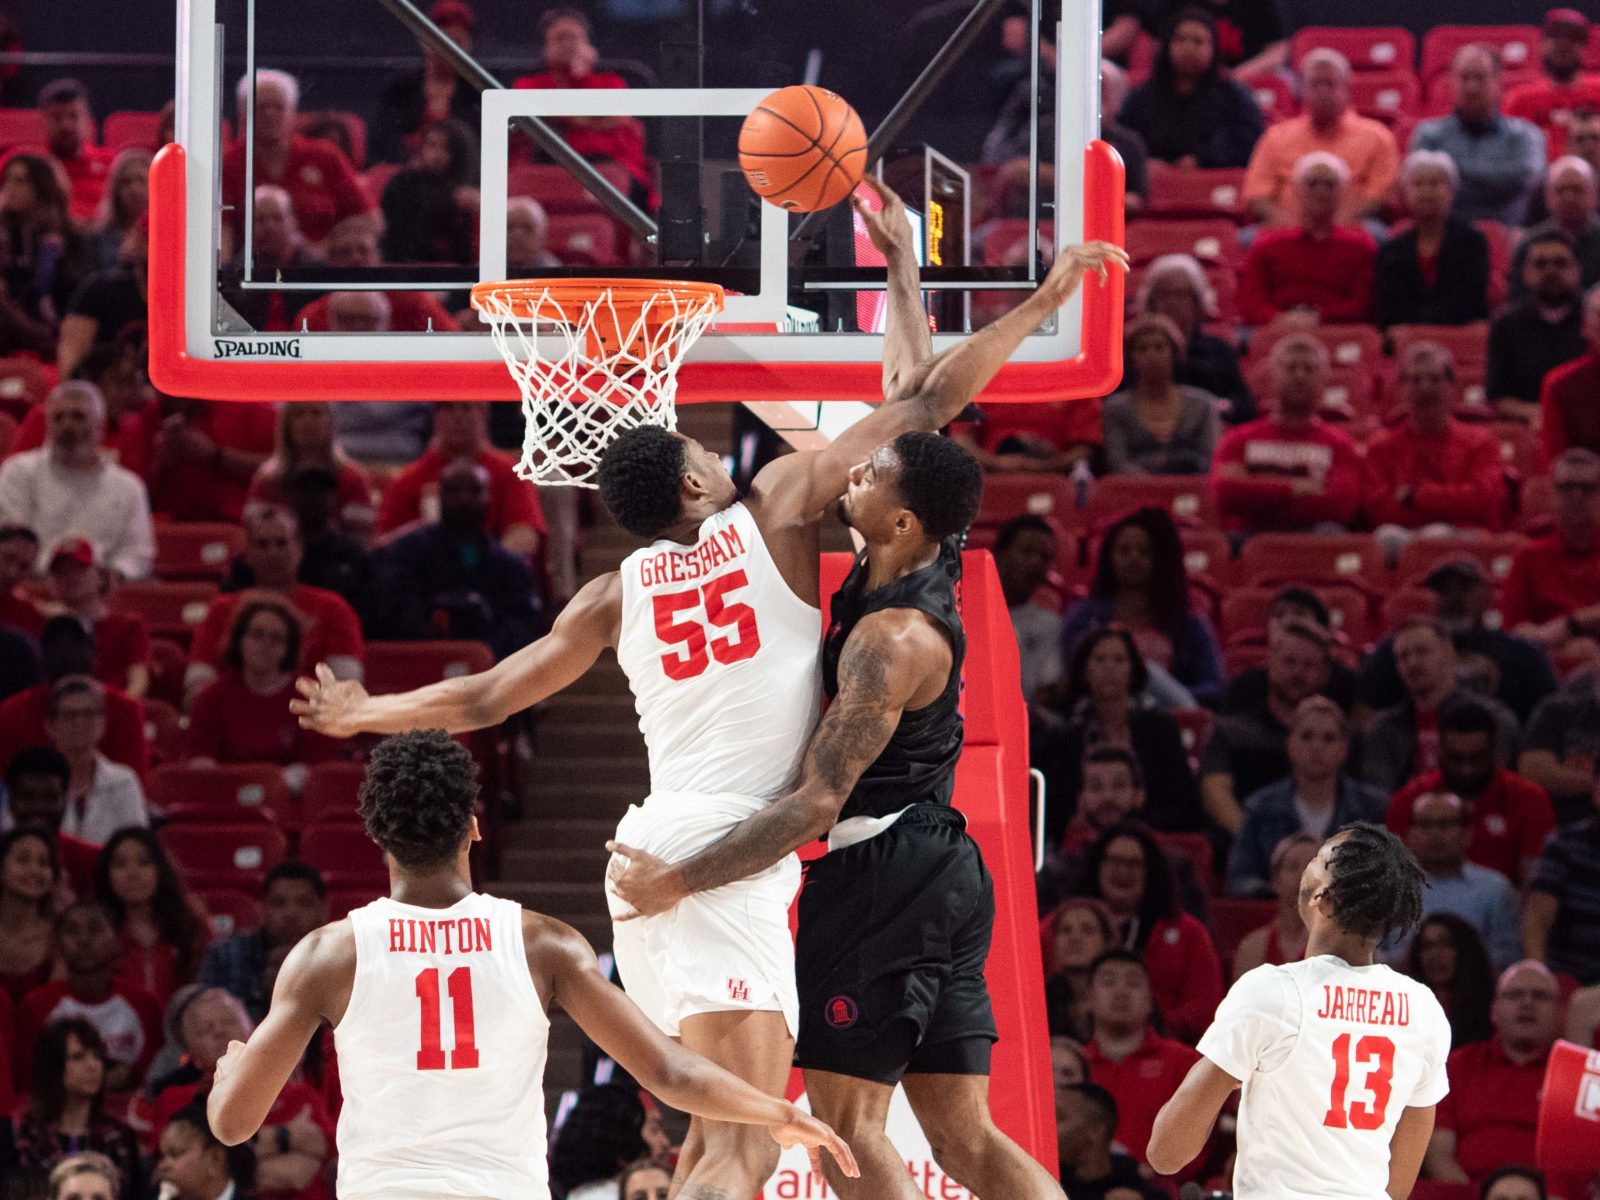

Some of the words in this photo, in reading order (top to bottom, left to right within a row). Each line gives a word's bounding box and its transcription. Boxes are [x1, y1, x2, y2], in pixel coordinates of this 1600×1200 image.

[214, 339, 302, 358] SPALDING
[640, 523, 746, 588] GRESHAM
[652, 569, 761, 681] 55
[388, 918, 493, 955] HINTON
[415, 966, 480, 1071] 11
[1317, 985, 1410, 1027] JARREAU
[1323, 1033, 1396, 1131] 13
